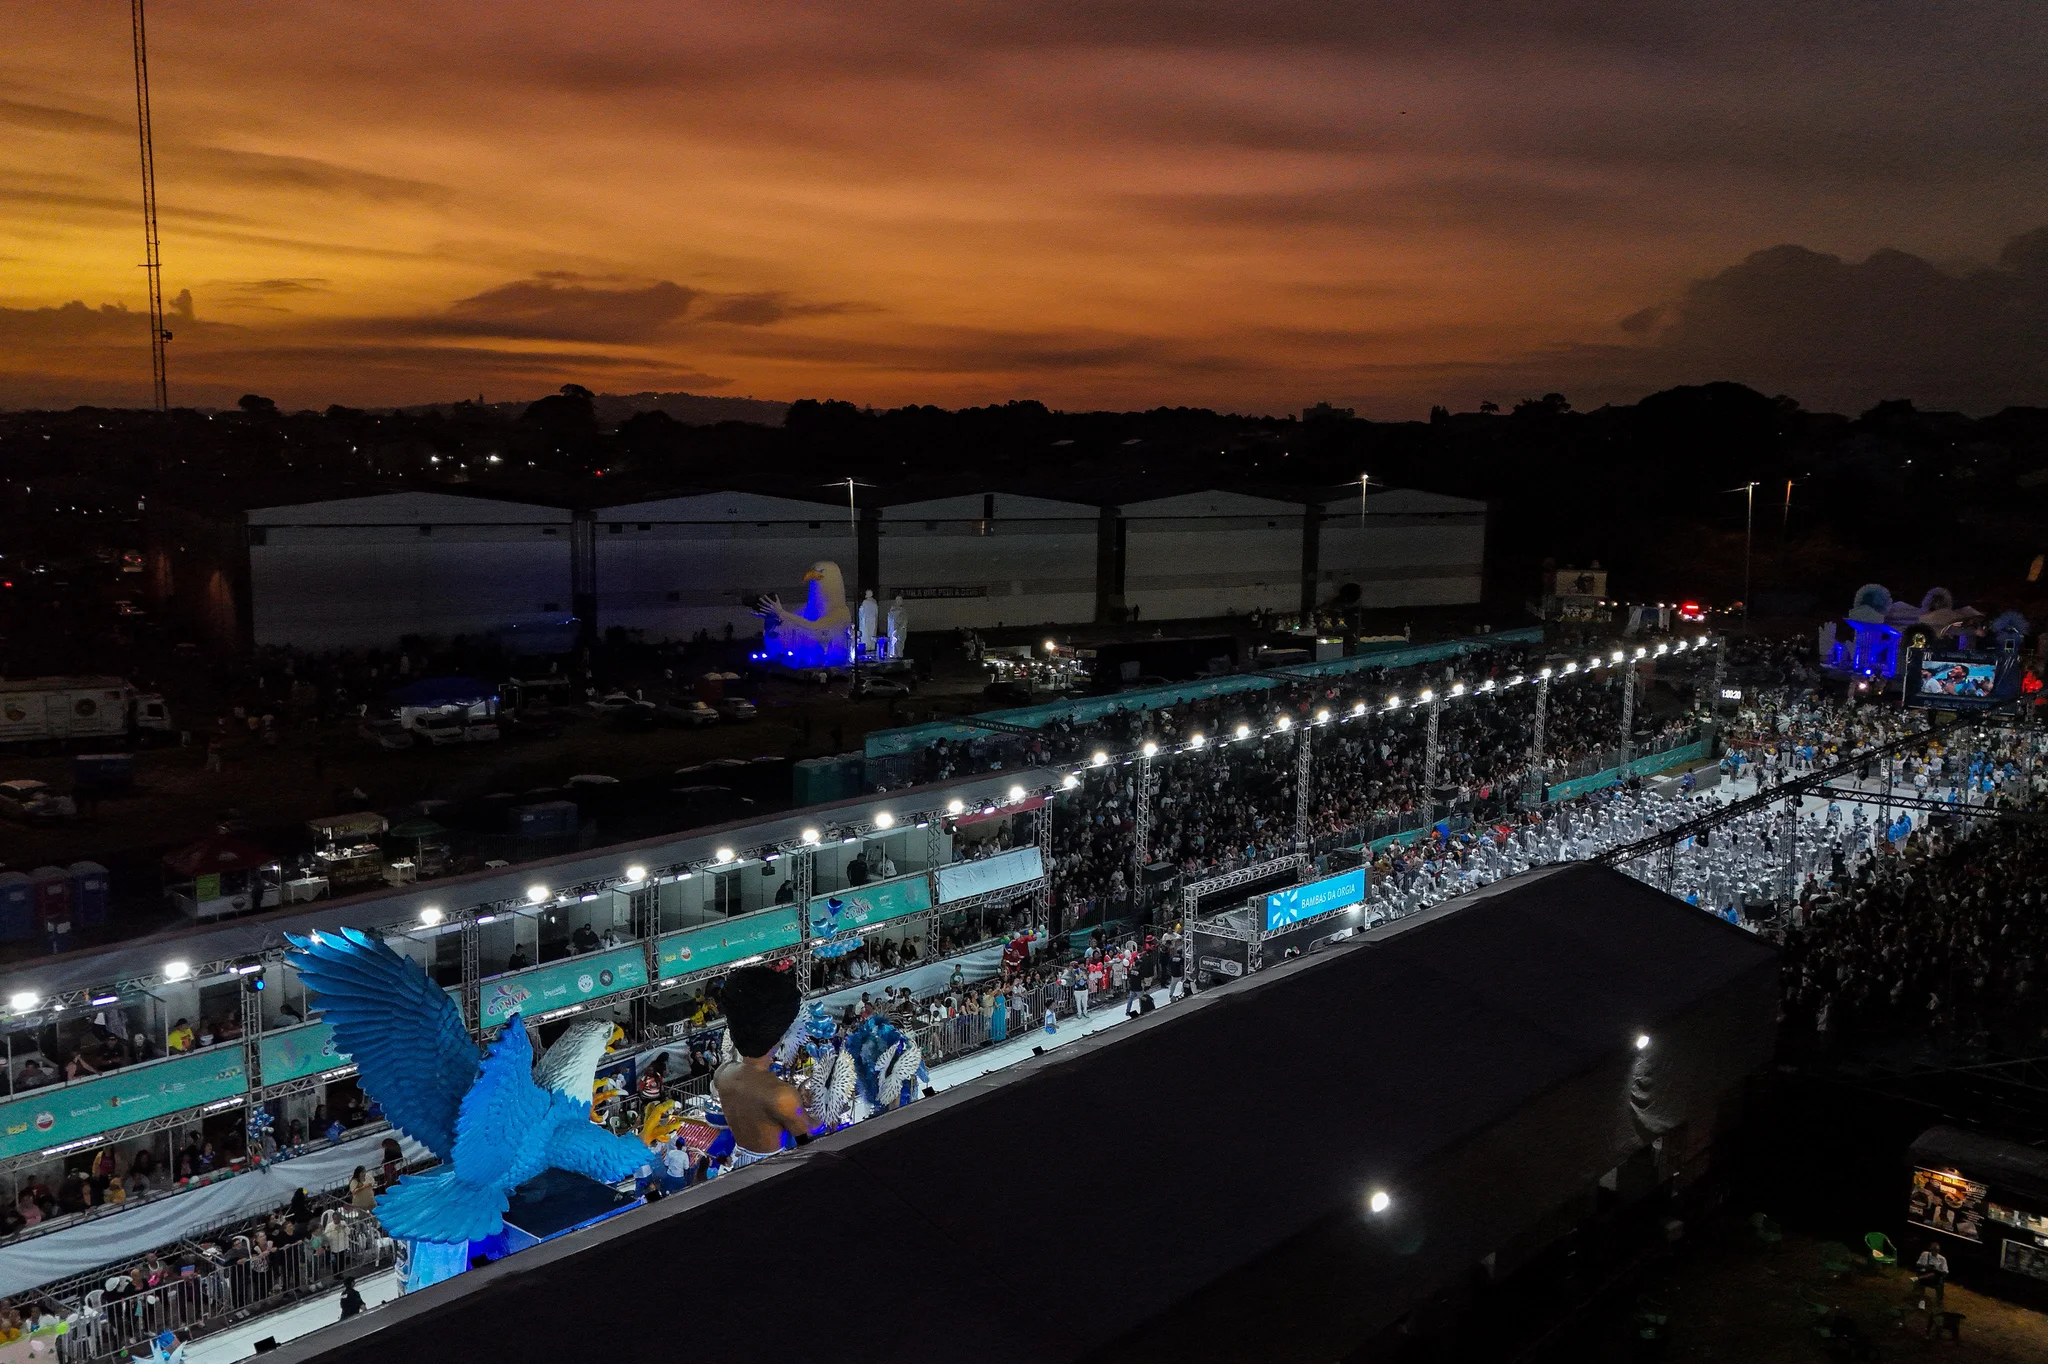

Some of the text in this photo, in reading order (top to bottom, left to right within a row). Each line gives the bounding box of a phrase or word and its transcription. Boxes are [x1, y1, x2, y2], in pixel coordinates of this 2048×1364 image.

[1301, 883, 1356, 909] BAMBAS DA ORGIA
[674, 1023, 683, 1033] 27
